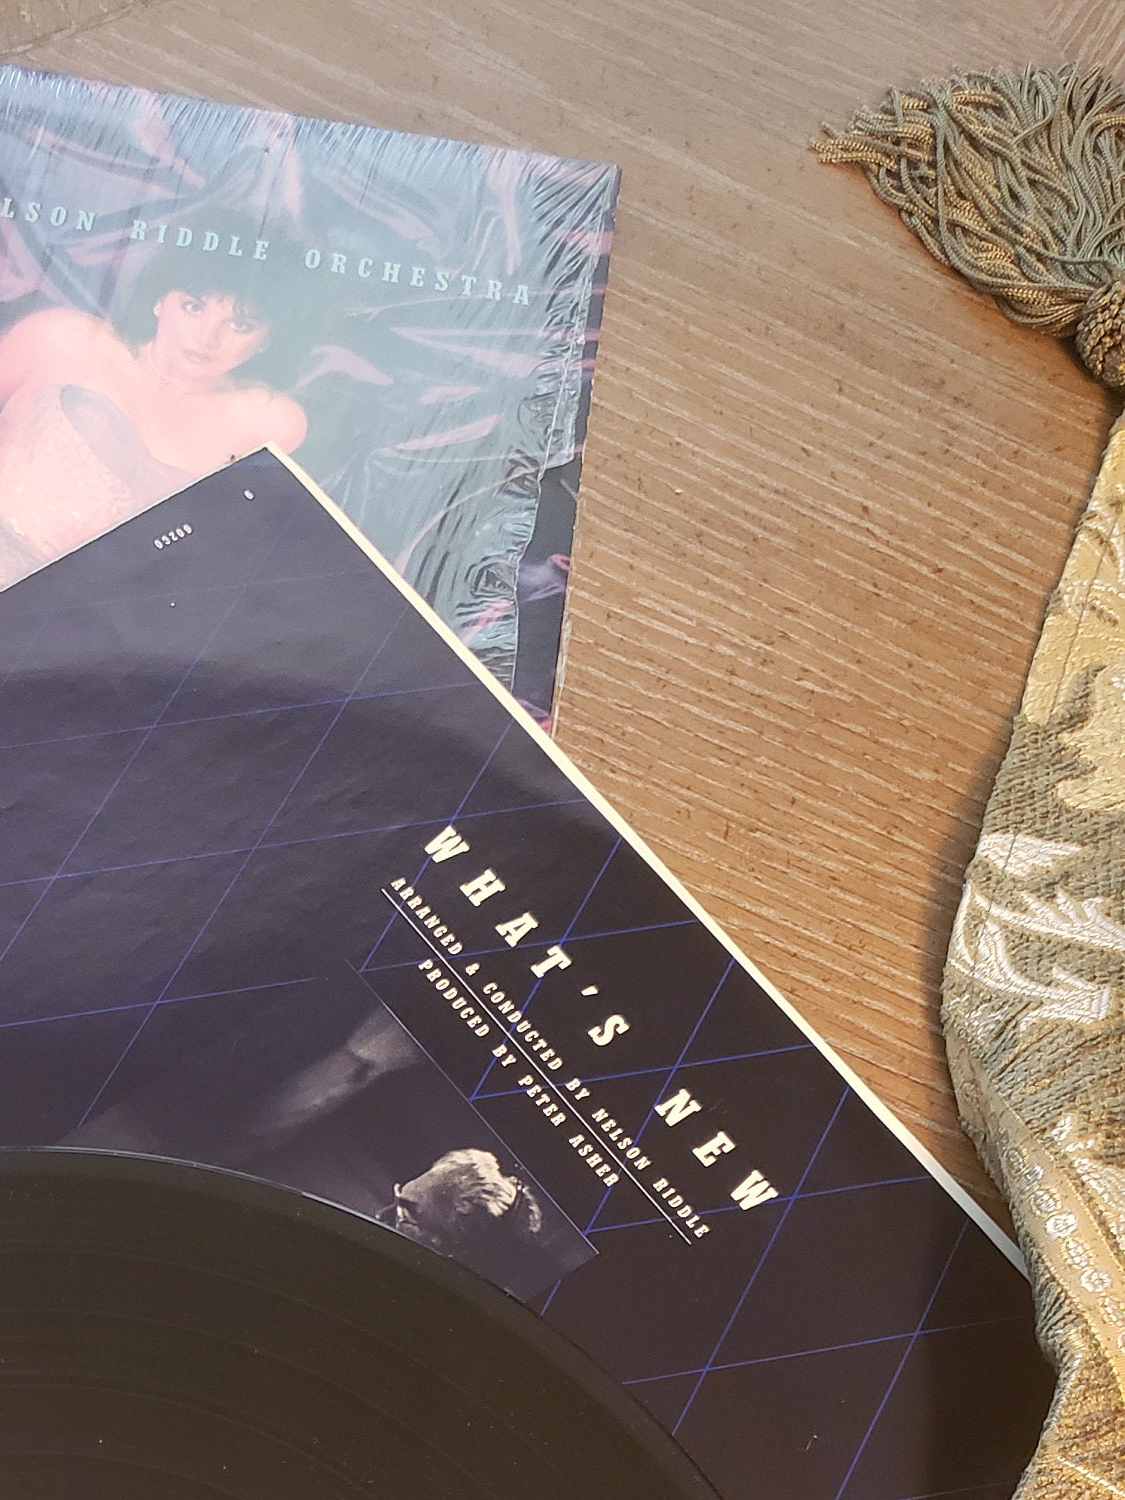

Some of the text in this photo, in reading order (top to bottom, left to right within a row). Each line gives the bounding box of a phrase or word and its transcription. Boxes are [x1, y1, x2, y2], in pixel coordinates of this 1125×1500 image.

[129, 219, 271, 261] RIDDLE
[305, 248, 531, 306] ORCHESTRA
[390, 877, 711, 1239] ARRANGED & CONDUCTED BY NELSON RIDDLE
[418, 959, 621, 1189] PRODUCED BY PETER ASHER
[424, 825, 779, 1211] WHAT'S NEW
